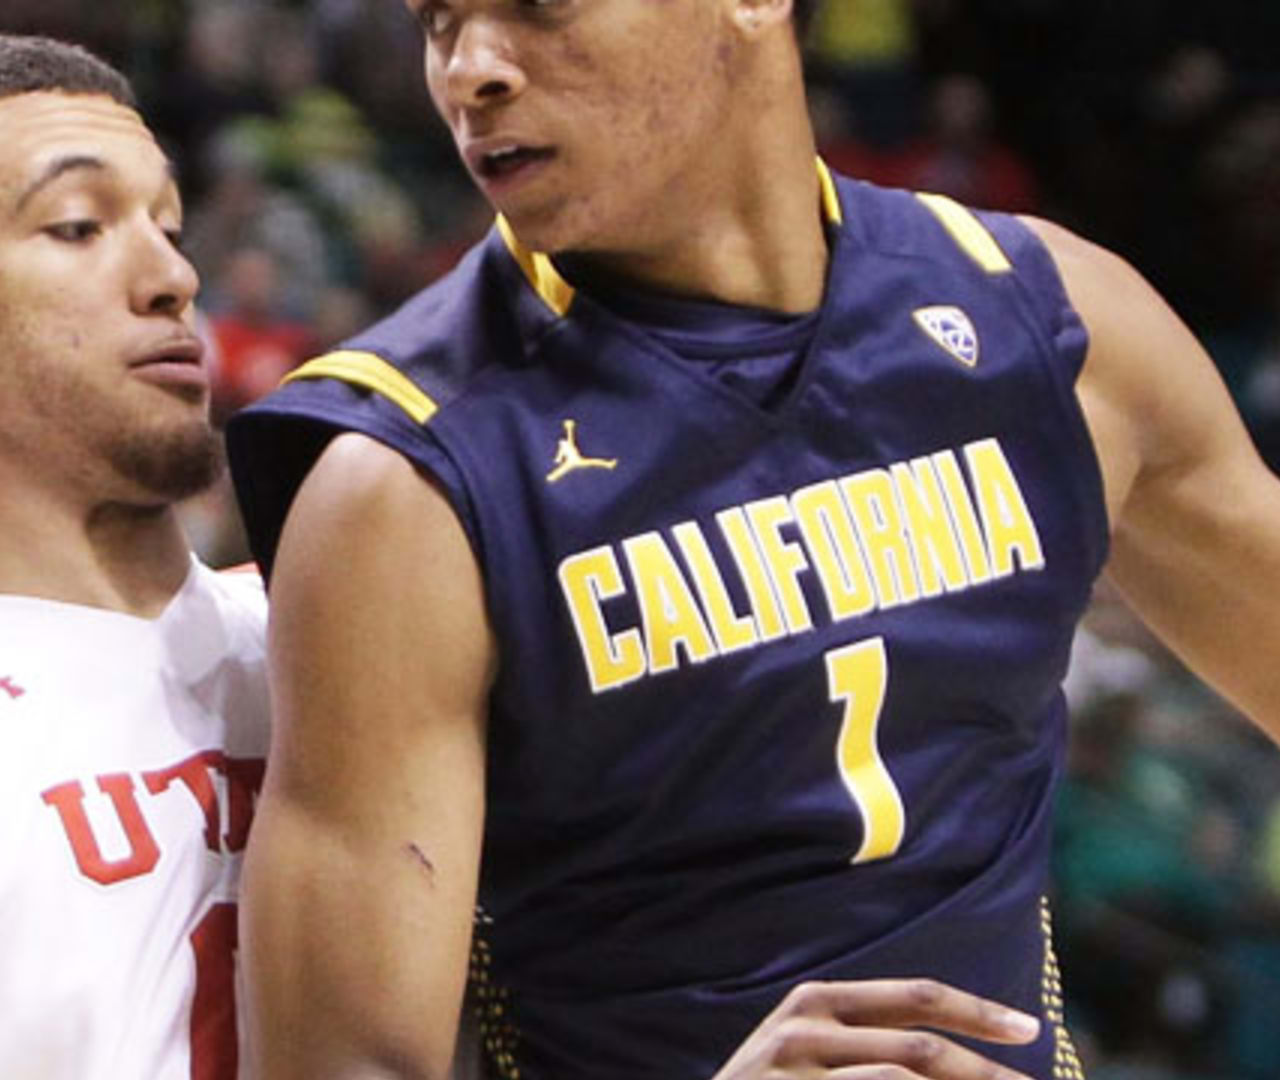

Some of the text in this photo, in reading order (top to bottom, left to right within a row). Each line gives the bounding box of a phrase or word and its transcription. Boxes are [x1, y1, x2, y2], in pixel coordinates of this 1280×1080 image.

[558, 437, 1045, 694] CALIFORNIA
[40, 749, 269, 887] UT
[824, 636, 906, 864] 1
